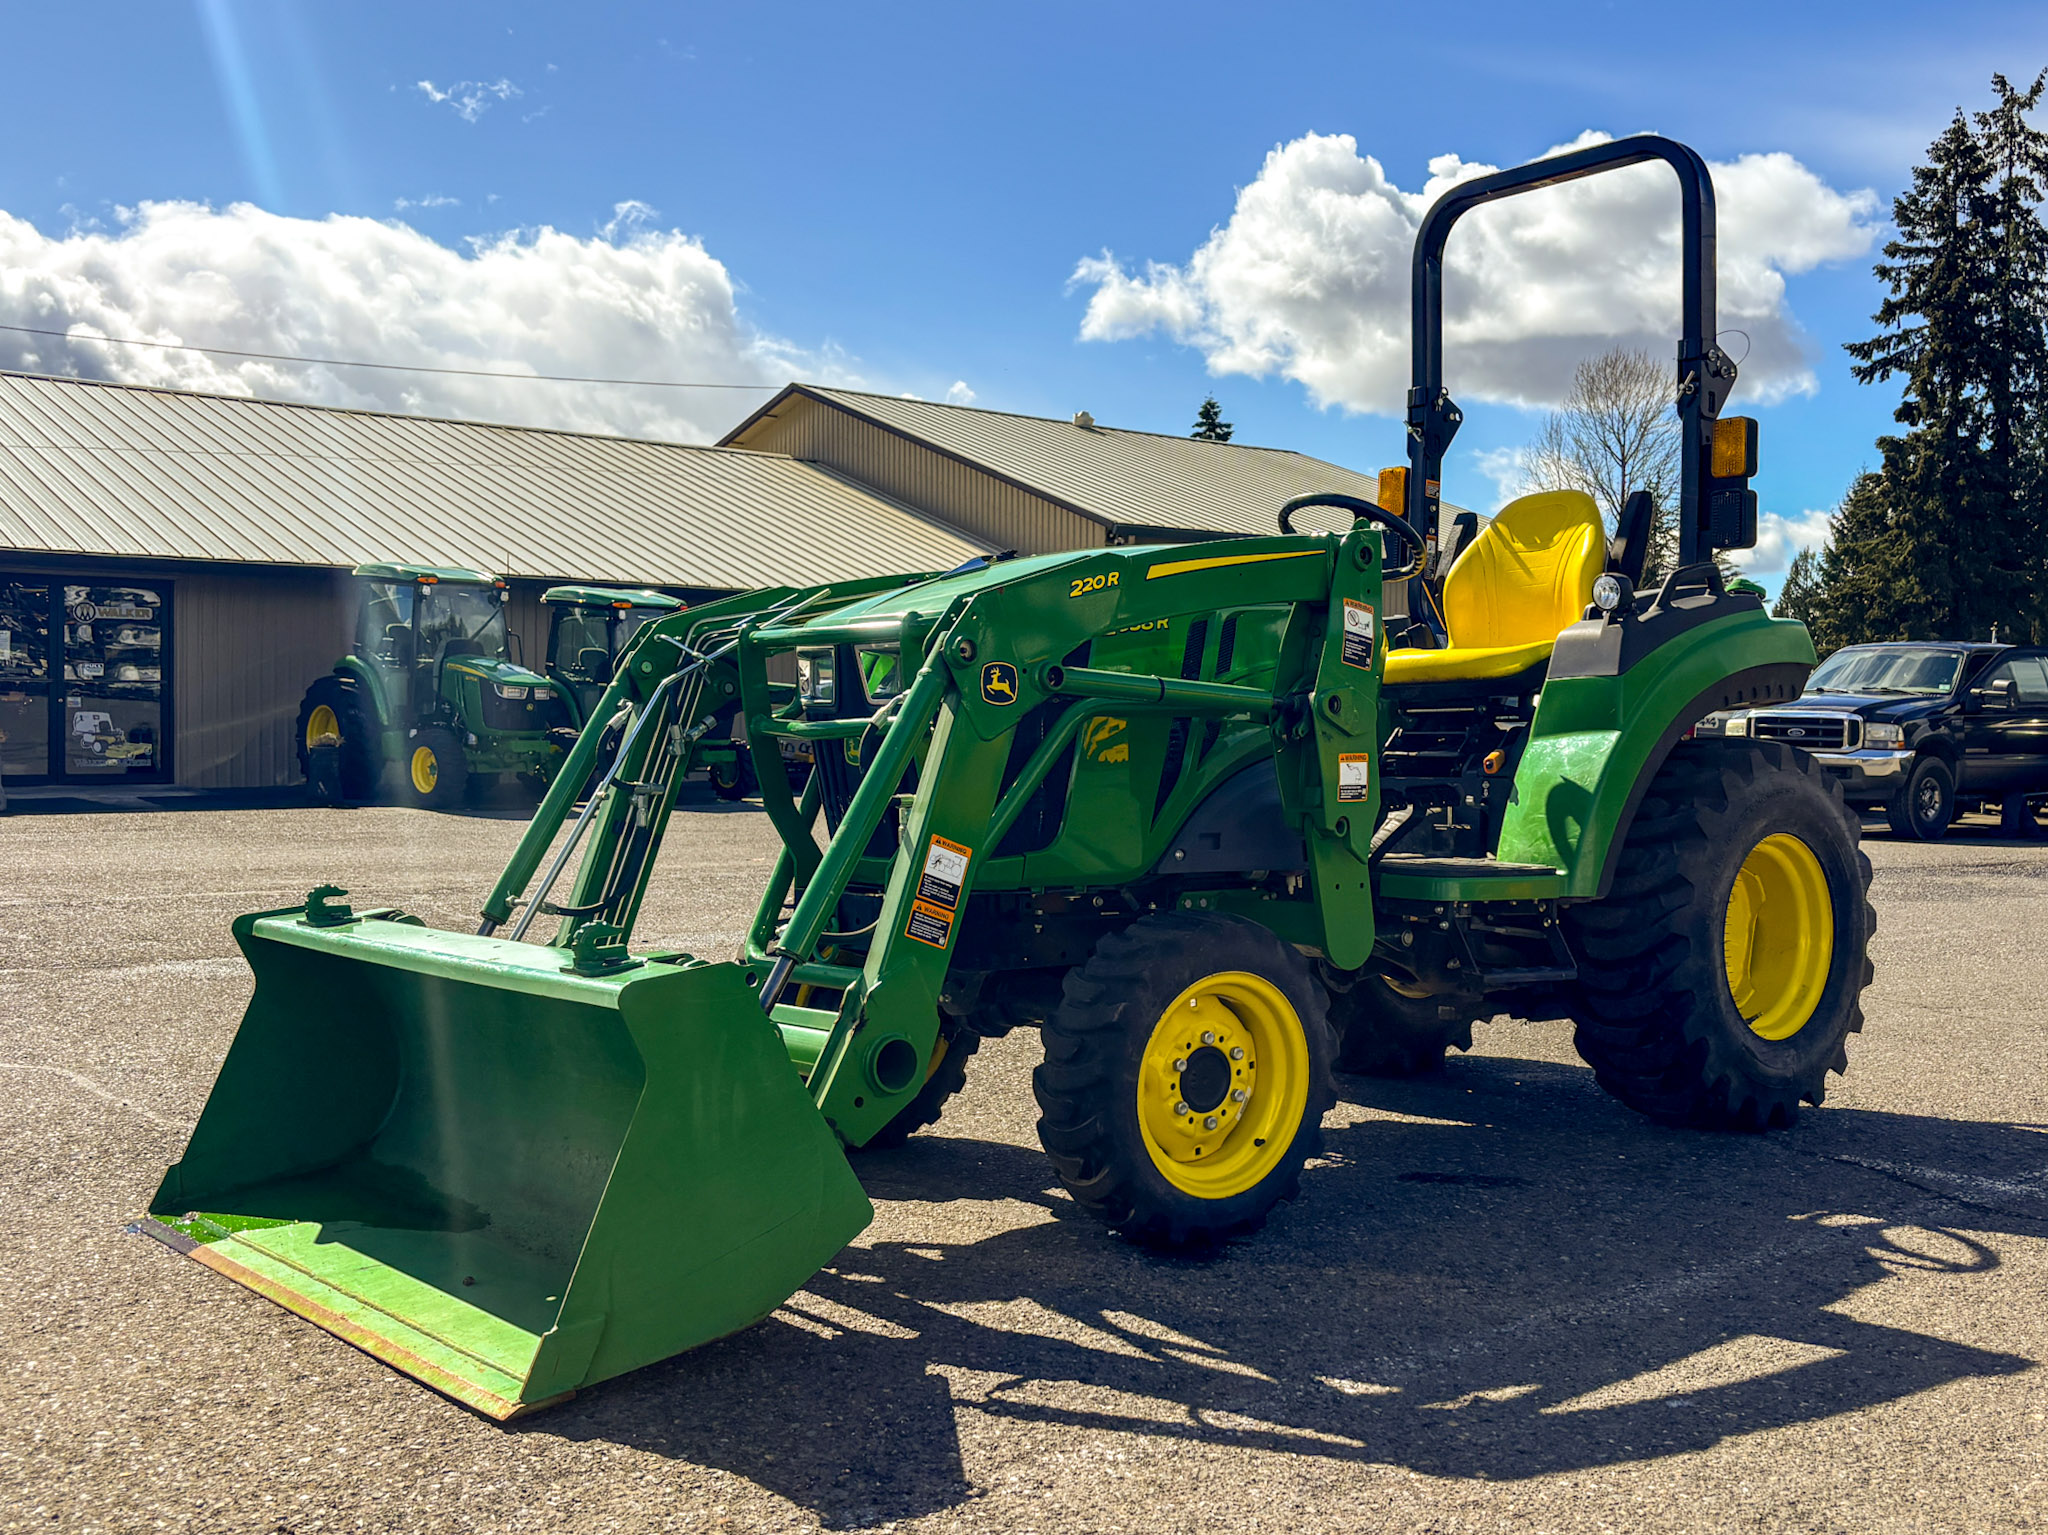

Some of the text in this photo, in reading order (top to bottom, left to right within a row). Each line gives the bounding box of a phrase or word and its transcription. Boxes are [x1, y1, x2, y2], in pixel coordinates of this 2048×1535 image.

[98, 607, 150, 618] WALKER
[942, 840, 967, 855] WARNING
[923, 905, 950, 920] WARNING
